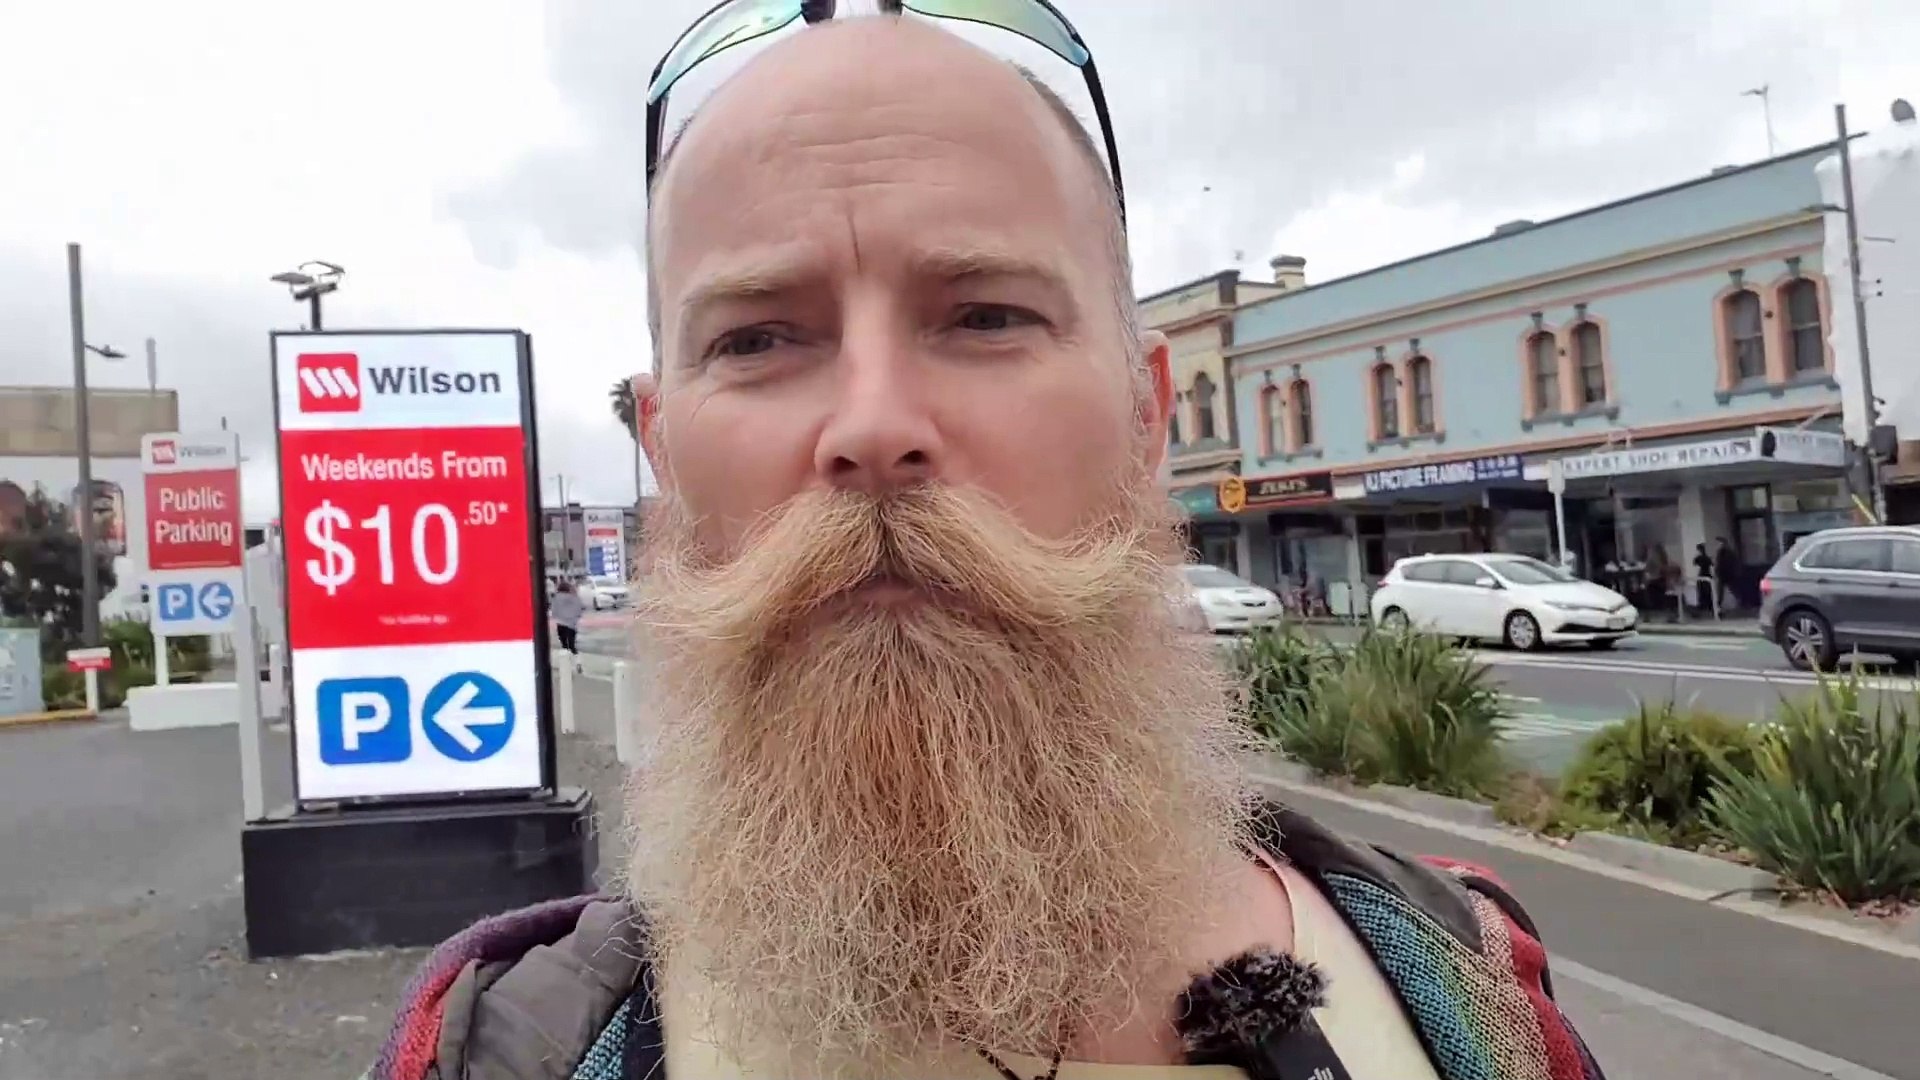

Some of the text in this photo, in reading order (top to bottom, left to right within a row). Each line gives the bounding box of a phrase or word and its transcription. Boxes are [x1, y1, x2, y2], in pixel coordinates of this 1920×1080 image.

[368, 366, 502, 395] Wilson
[301, 450, 508, 482] Weekends From
[159, 486, 225, 512] Public
[155, 519, 233, 547] Parking
[341, 691, 392, 752] P
